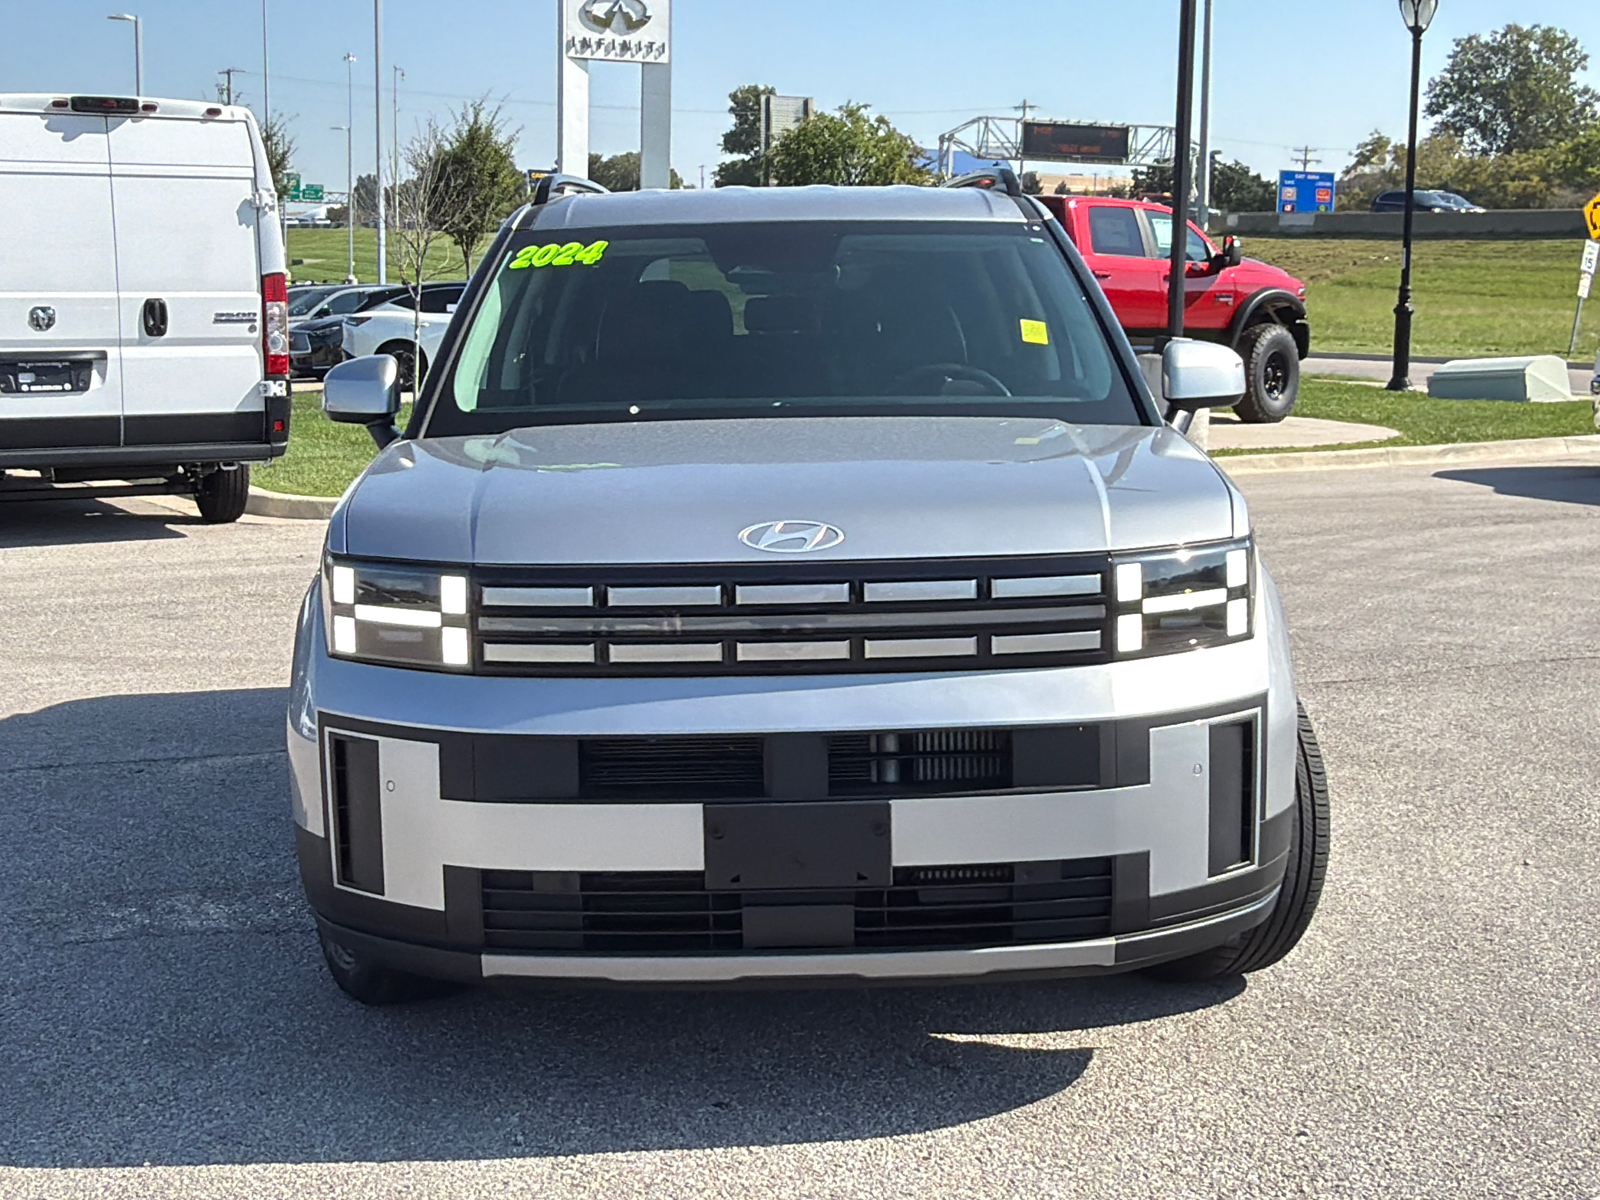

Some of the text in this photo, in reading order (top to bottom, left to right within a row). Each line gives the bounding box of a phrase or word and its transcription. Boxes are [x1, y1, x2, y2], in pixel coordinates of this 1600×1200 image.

[571, 36, 665, 55] INFINITI
[509, 240, 609, 270] 2024
[1585, 257, 1593, 269] 15
